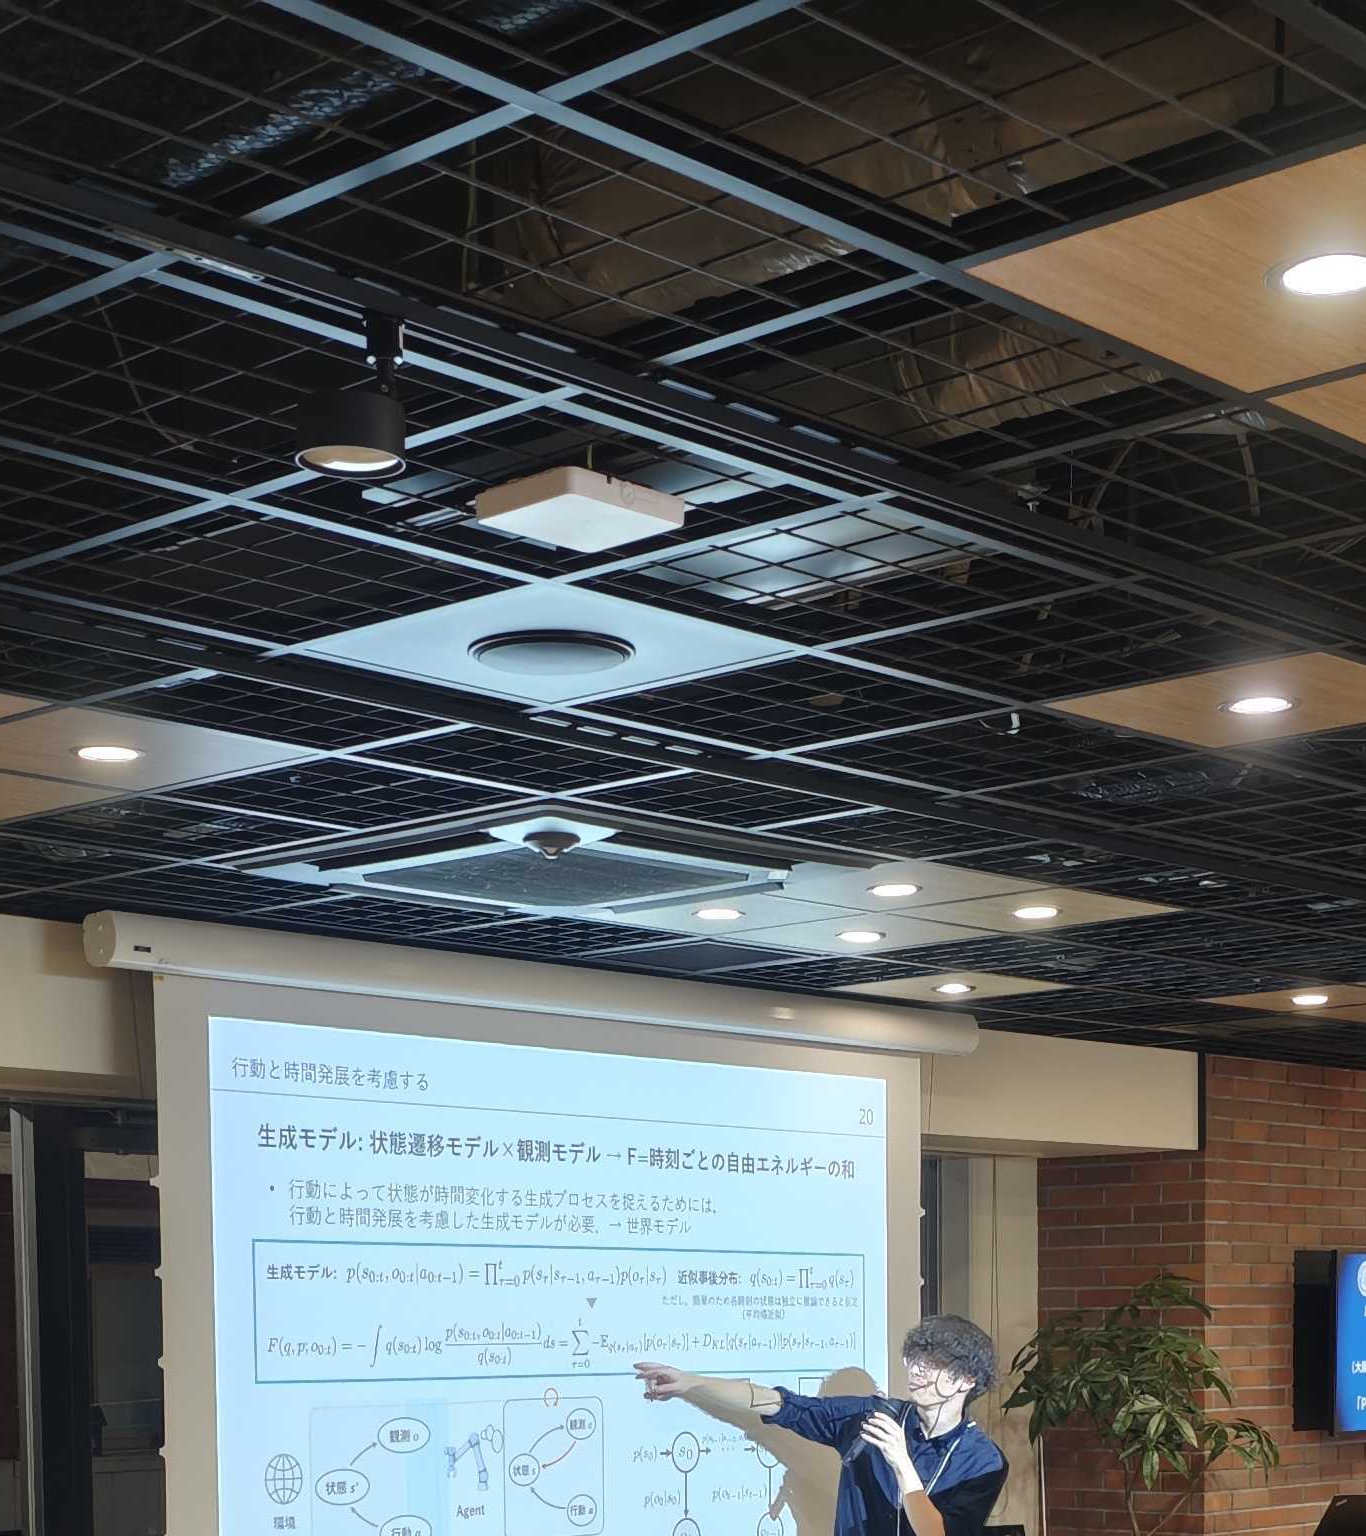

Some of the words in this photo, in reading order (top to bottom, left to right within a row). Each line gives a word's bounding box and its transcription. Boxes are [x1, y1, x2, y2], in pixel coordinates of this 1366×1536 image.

[231, 1056, 429, 1091] 行動と時間発展を考慮する
[859, 1108, 874, 1127] 20
[456, 1504, 486, 1520] Agent
